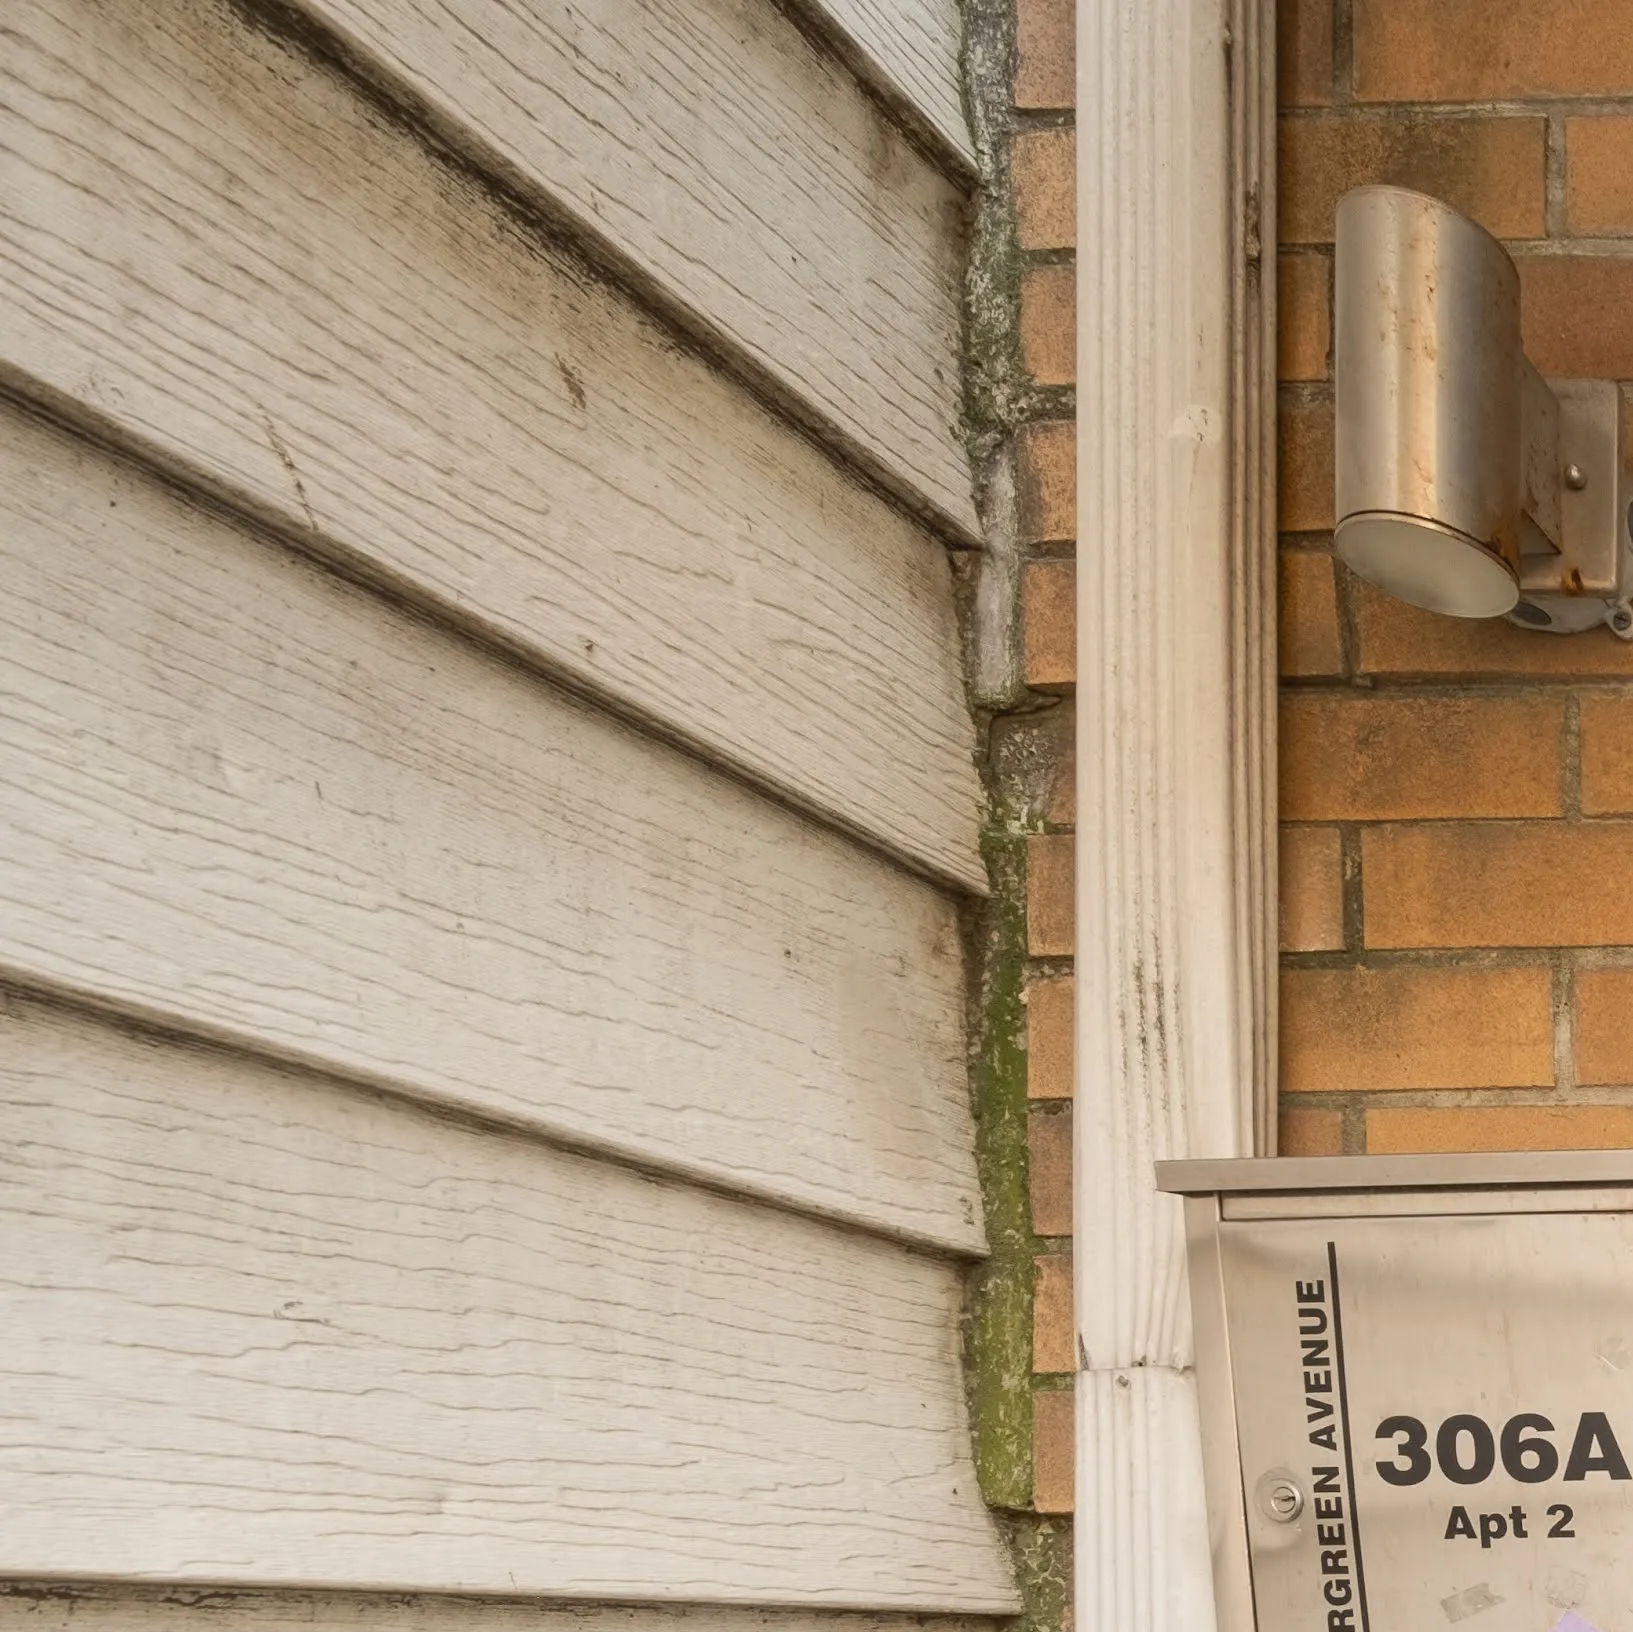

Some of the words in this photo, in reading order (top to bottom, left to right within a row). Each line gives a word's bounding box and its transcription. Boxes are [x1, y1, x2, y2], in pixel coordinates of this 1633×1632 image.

[1295, 1279, 1338, 1451] AVENUE
[1374, 1411, 1633, 1487] 306A
[1444, 1505, 1529, 1549] Apt
[1546, 1503, 1576, 1539] 2
